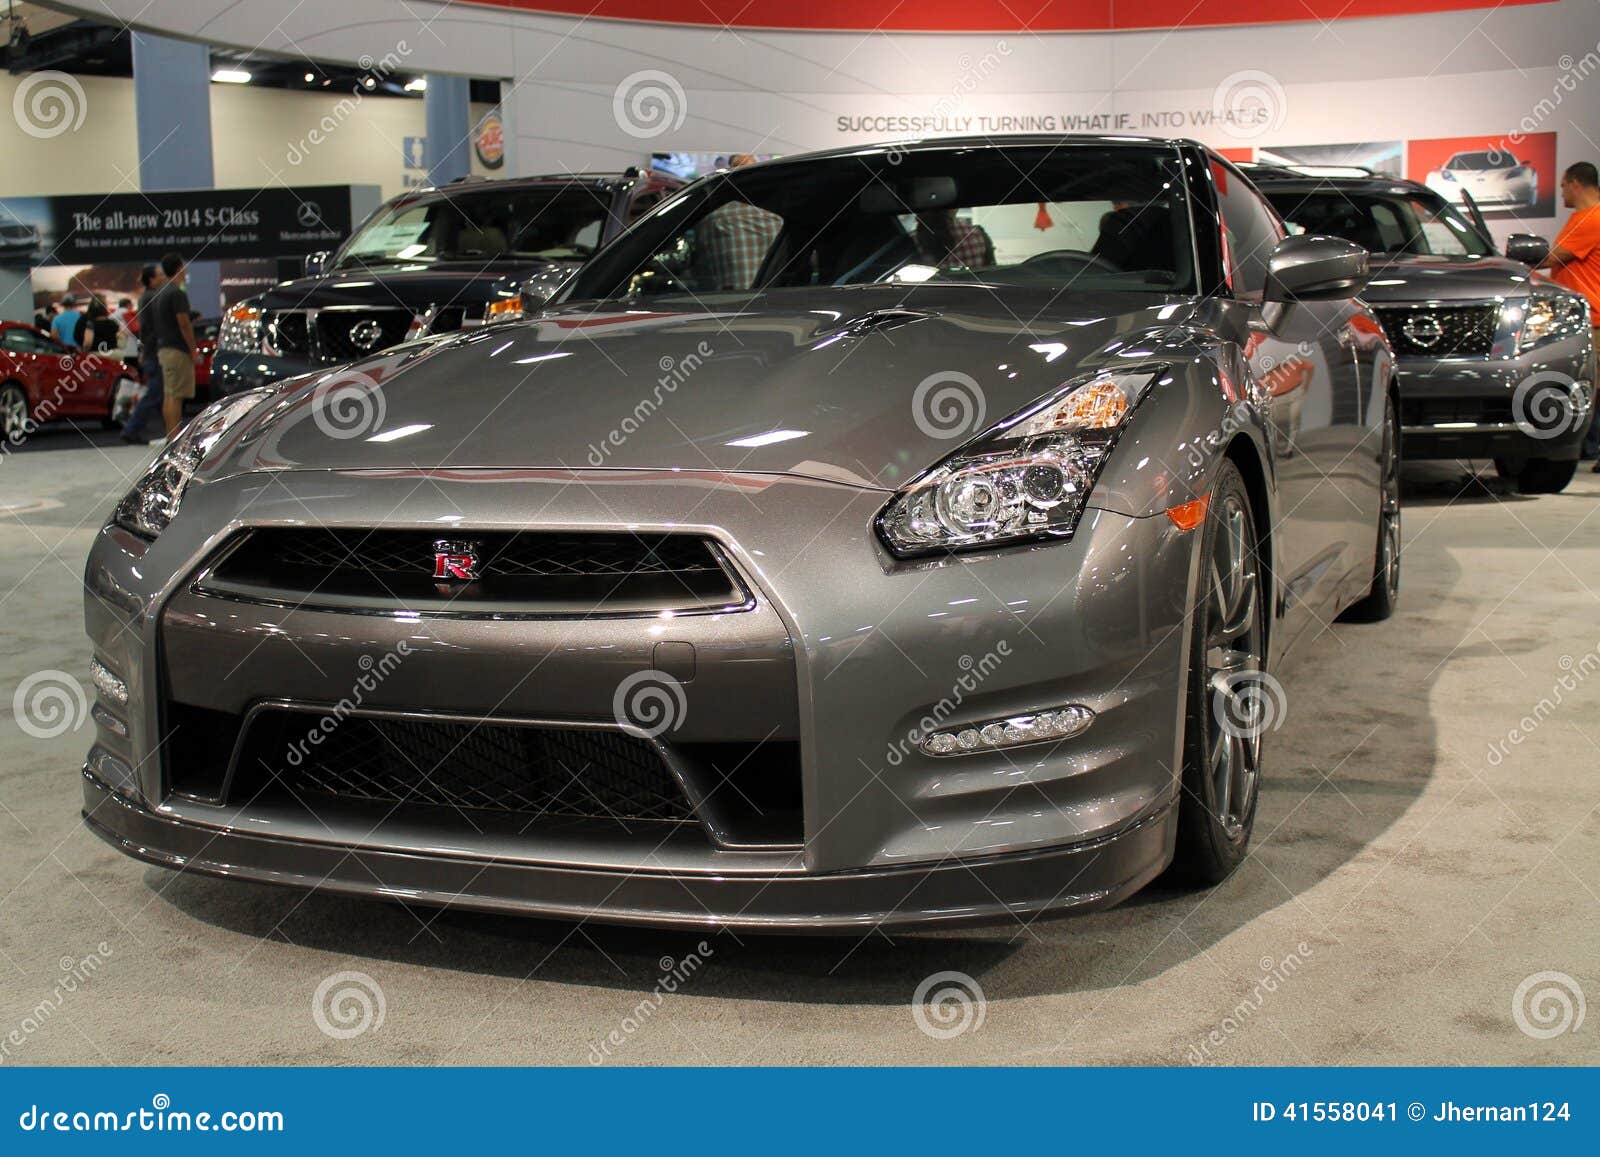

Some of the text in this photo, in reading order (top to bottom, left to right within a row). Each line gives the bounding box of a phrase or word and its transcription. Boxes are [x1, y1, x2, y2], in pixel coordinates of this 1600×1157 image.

[836, 116, 973, 132] SUCCESSFULLY
[979, 116, 1056, 131] TURNING
[1060, 114, 1111, 130] WHAT
[1142, 111, 1185, 128] INTO
[1190, 109, 1246, 127] WHAT
[1250, 108, 1268, 125] IS
[73, 207, 259, 232] The all-new 2014 S-Class
